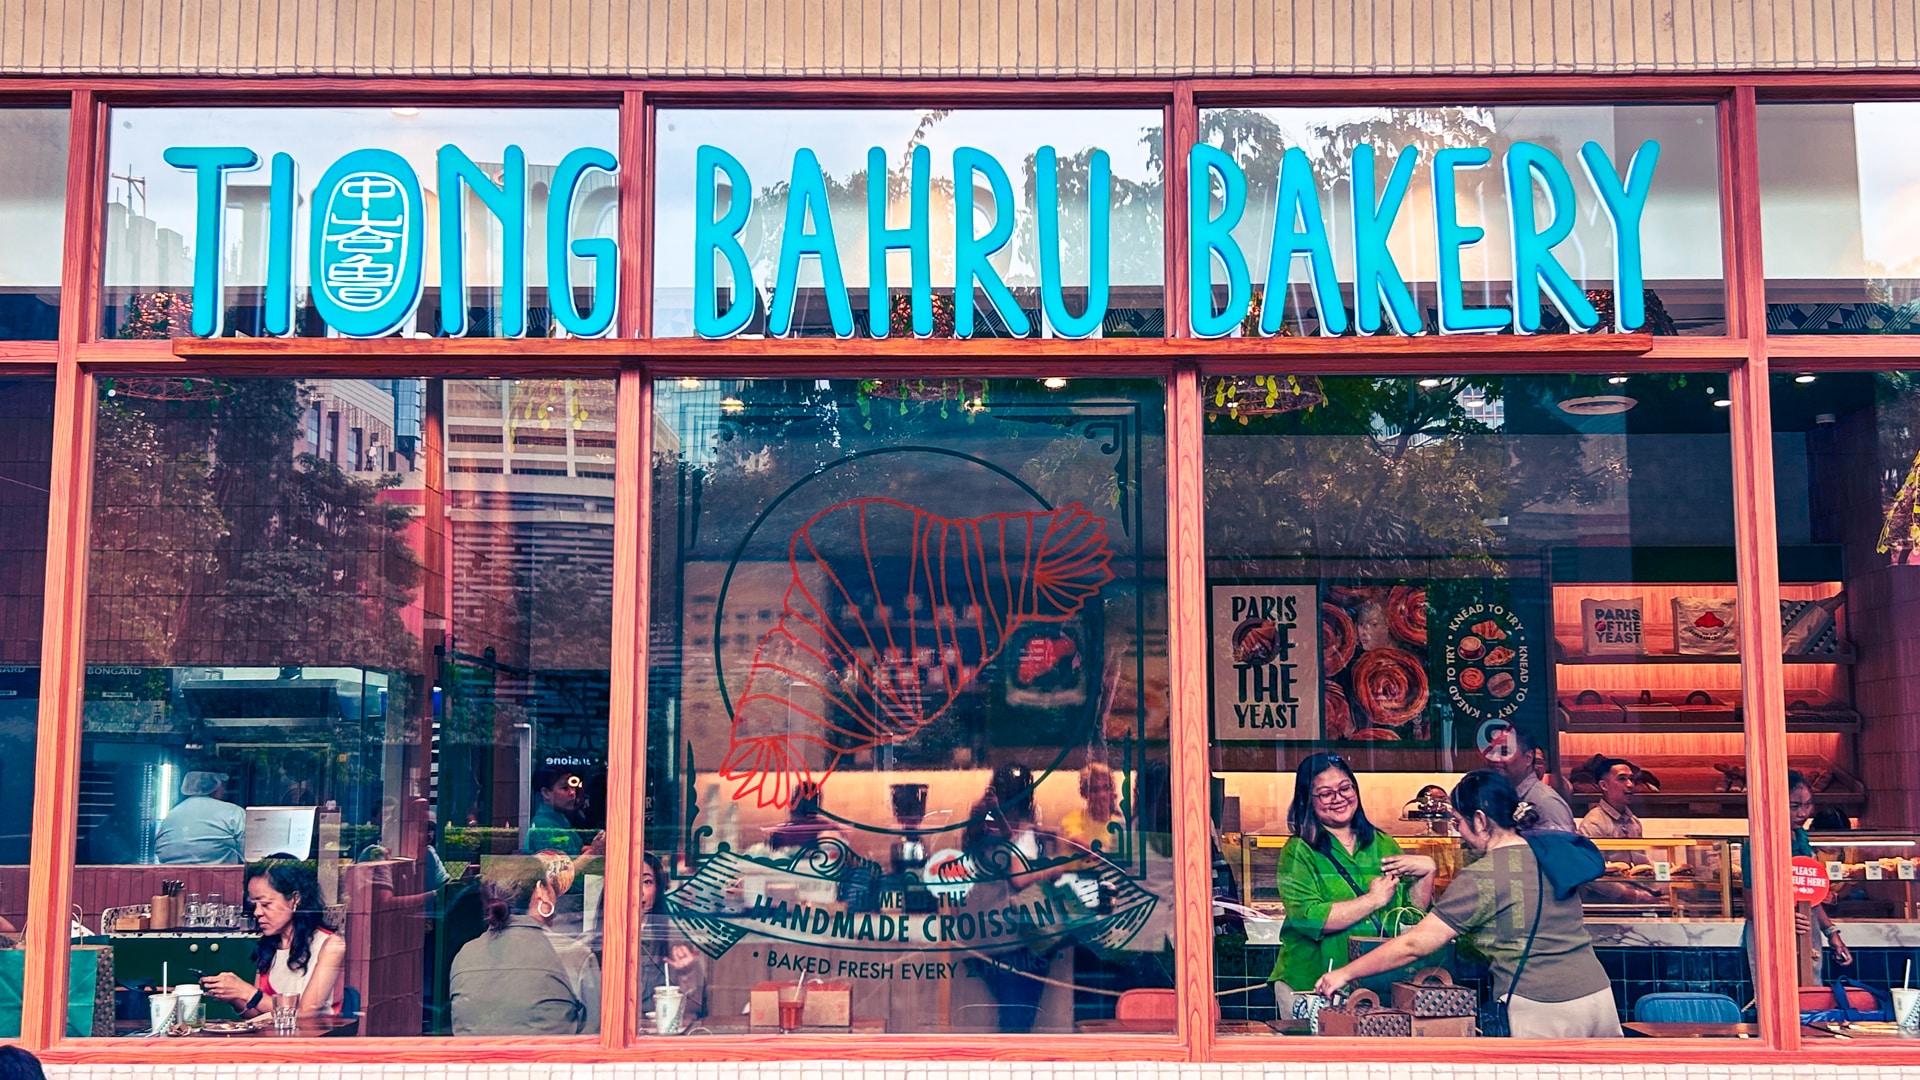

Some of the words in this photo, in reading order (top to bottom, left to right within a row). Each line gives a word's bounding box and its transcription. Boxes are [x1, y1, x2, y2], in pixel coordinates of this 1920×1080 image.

[163, 143, 621, 339] TIONG
[694, 144, 1110, 339] BAHRU
[1187, 139, 1661, 339] BAKERY
[1231, 595, 1297, 622] PARIS
[1448, 604, 1484, 631] KNEAD
[1488, 603, 1504, 615] TO
[1505, 611, 1524, 631] TRY
[1595, 608, 1641, 620] PARIS
[1595, 632, 1641, 643] YEAST
[1446, 645, 1455, 664] TRY
[1518, 645, 1529, 683] KNEAD
[87, 667, 142, 675] BONGARD
[1446, 667, 1456, 682] TO
[1233, 663, 1299, 704] THE
[1449, 685, 1481, 718] KNEAD
[1516, 687, 1529, 702] TO
[1233, 704, 1299, 730] YEAST
[1498, 702, 1519, 719] TRY
[1792, 866, 1818, 877] PLEASE
[1807, 877, 1826, 888] HERE
[937, 890, 967, 909] THE
[750, 894, 910, 943] HANDMADE
[922, 893, 1071, 943] CROISSANT
[767, 950, 831, 975] BAKED
[837, 960, 894, 980] FRESH
[901, 962, 958, 980] EVERY
